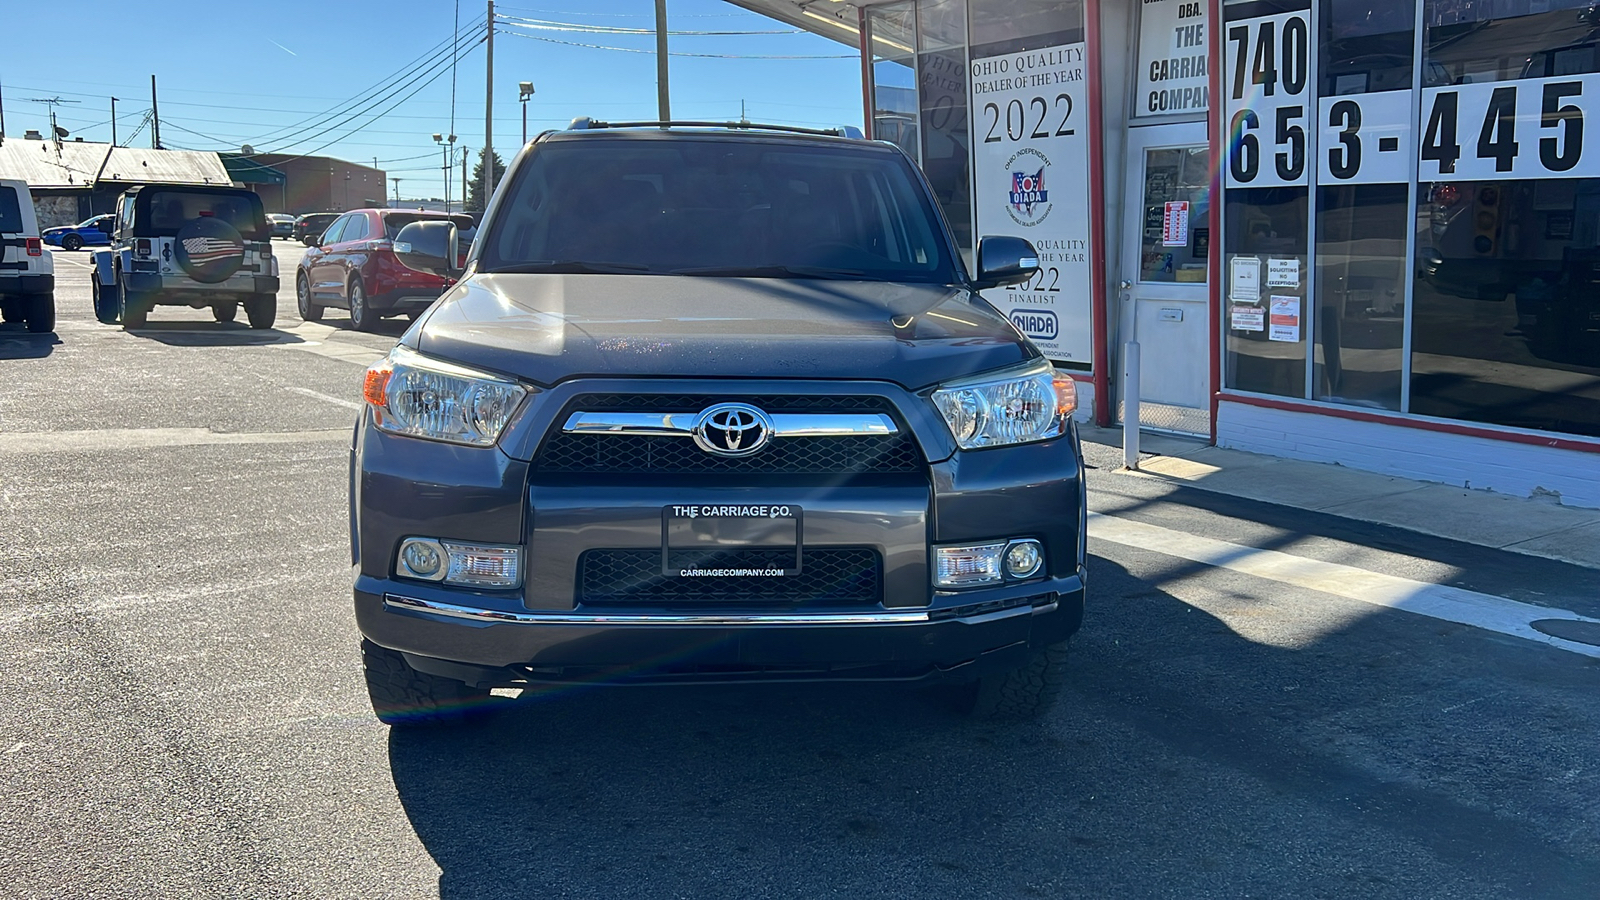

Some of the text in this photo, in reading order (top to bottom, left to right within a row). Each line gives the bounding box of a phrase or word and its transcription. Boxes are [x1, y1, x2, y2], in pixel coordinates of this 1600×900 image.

[1178, 2, 1203, 19] DBA.
[1175, 24, 1204, 48] THE
[972, 47, 1084, 77] OHIO QUALITY
[1149, 55, 1209, 82] CARRIA
[1228, 16, 1308, 100] 740
[922, 72, 962, 94] EALER
[974, 68, 1083, 95] DEALER OF THE YEAR
[1148, 86, 1209, 112] COMPAN
[983, 93, 1075, 143] 2022
[1004, 147, 1051, 171] OHIO INDEPENDENT
[1013, 191, 1042, 203] OIADA
[1036, 240, 1086, 251] QUALITY
[1058, 253, 1085, 262] YEAR
[1006, 267, 1060, 292] 22
[1009, 293, 1056, 304] FINALIST
[1013, 315, 1054, 333] NIADA
[1043, 350, 1072, 358] ASSOCIATION
[672, 505, 793, 517] THE CARRIAGE CO.
[680, 568, 784, 577] CARRIAGECOMPANY.COM
